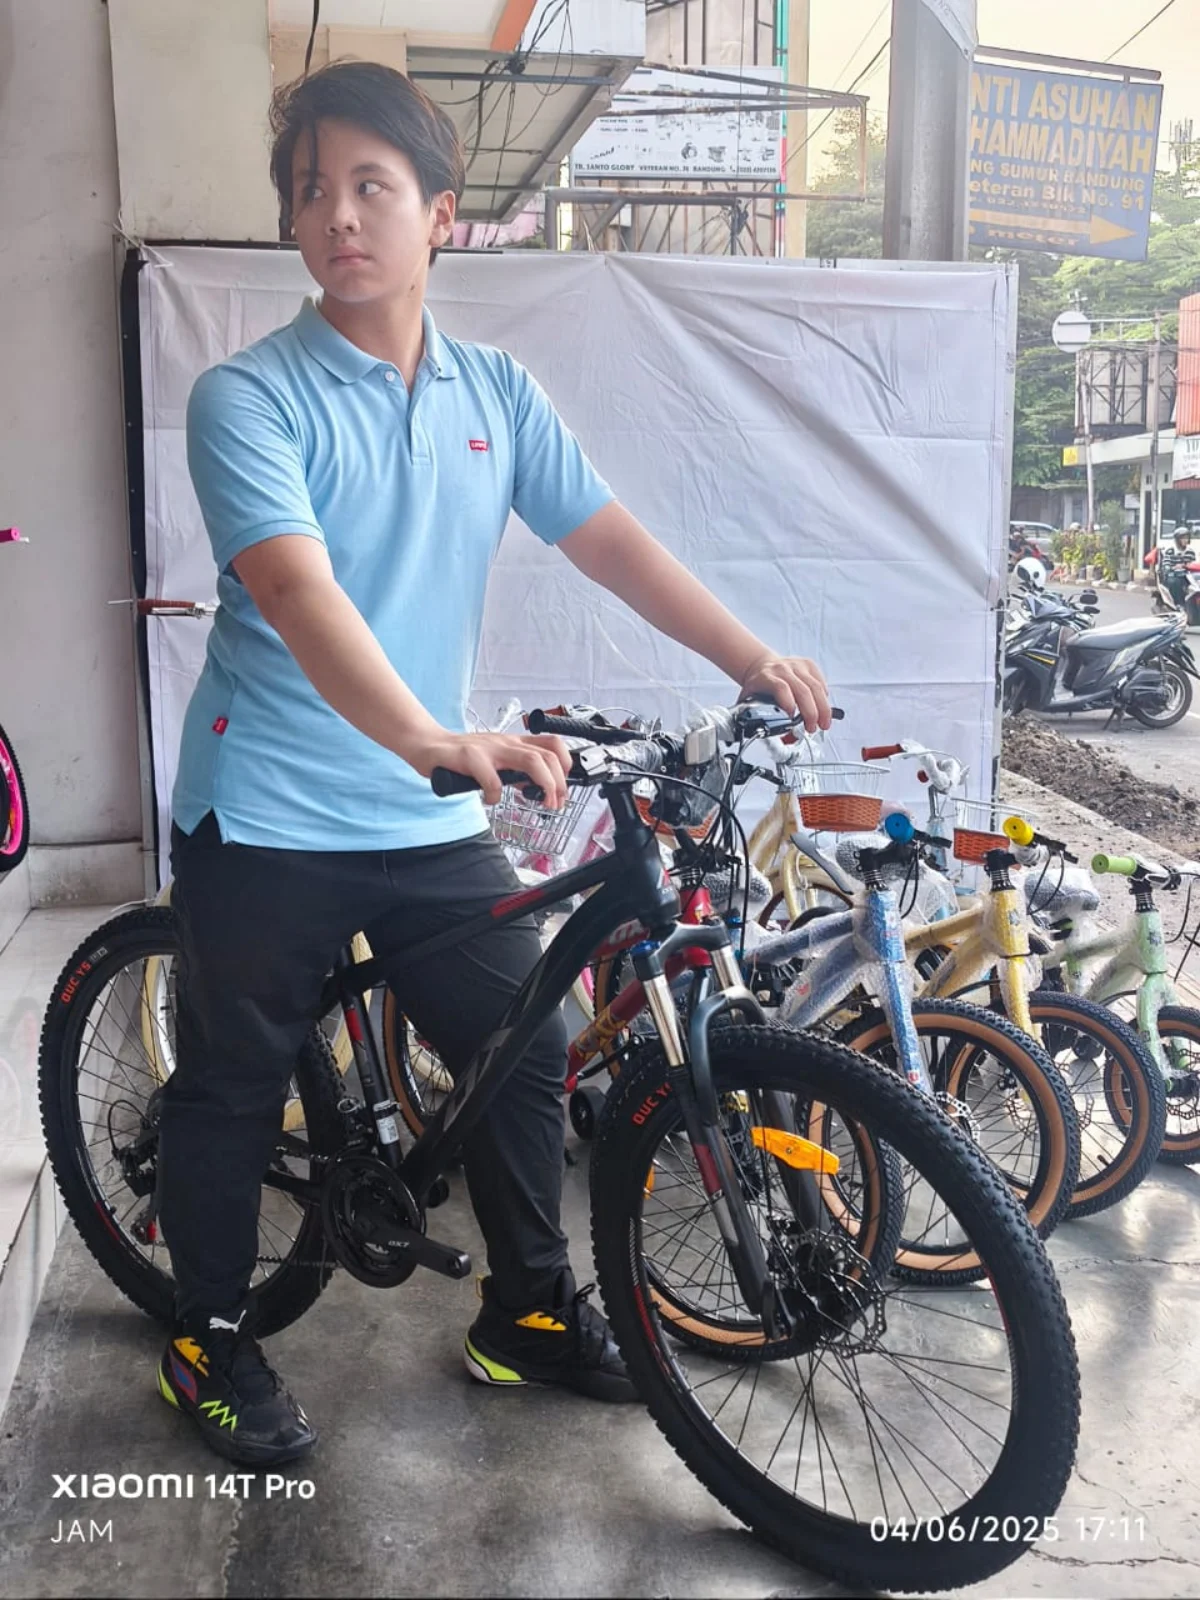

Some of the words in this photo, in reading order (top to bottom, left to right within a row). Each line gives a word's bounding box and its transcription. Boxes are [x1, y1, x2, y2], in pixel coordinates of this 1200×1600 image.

[971, 72, 1020, 116] NTI
[1028, 80, 1157, 133] ASUHAN
[969, 115, 1153, 174] HAMMADIYAH
[969, 178, 1035, 199] eteran
[1082, 187, 1114, 207] No.
[1121, 193, 1145, 211] 91
[970, 159, 994, 176] NG
[1000, 163, 1059, 183] SUMUR
[1063, 171, 1145, 192] BANDUNG
